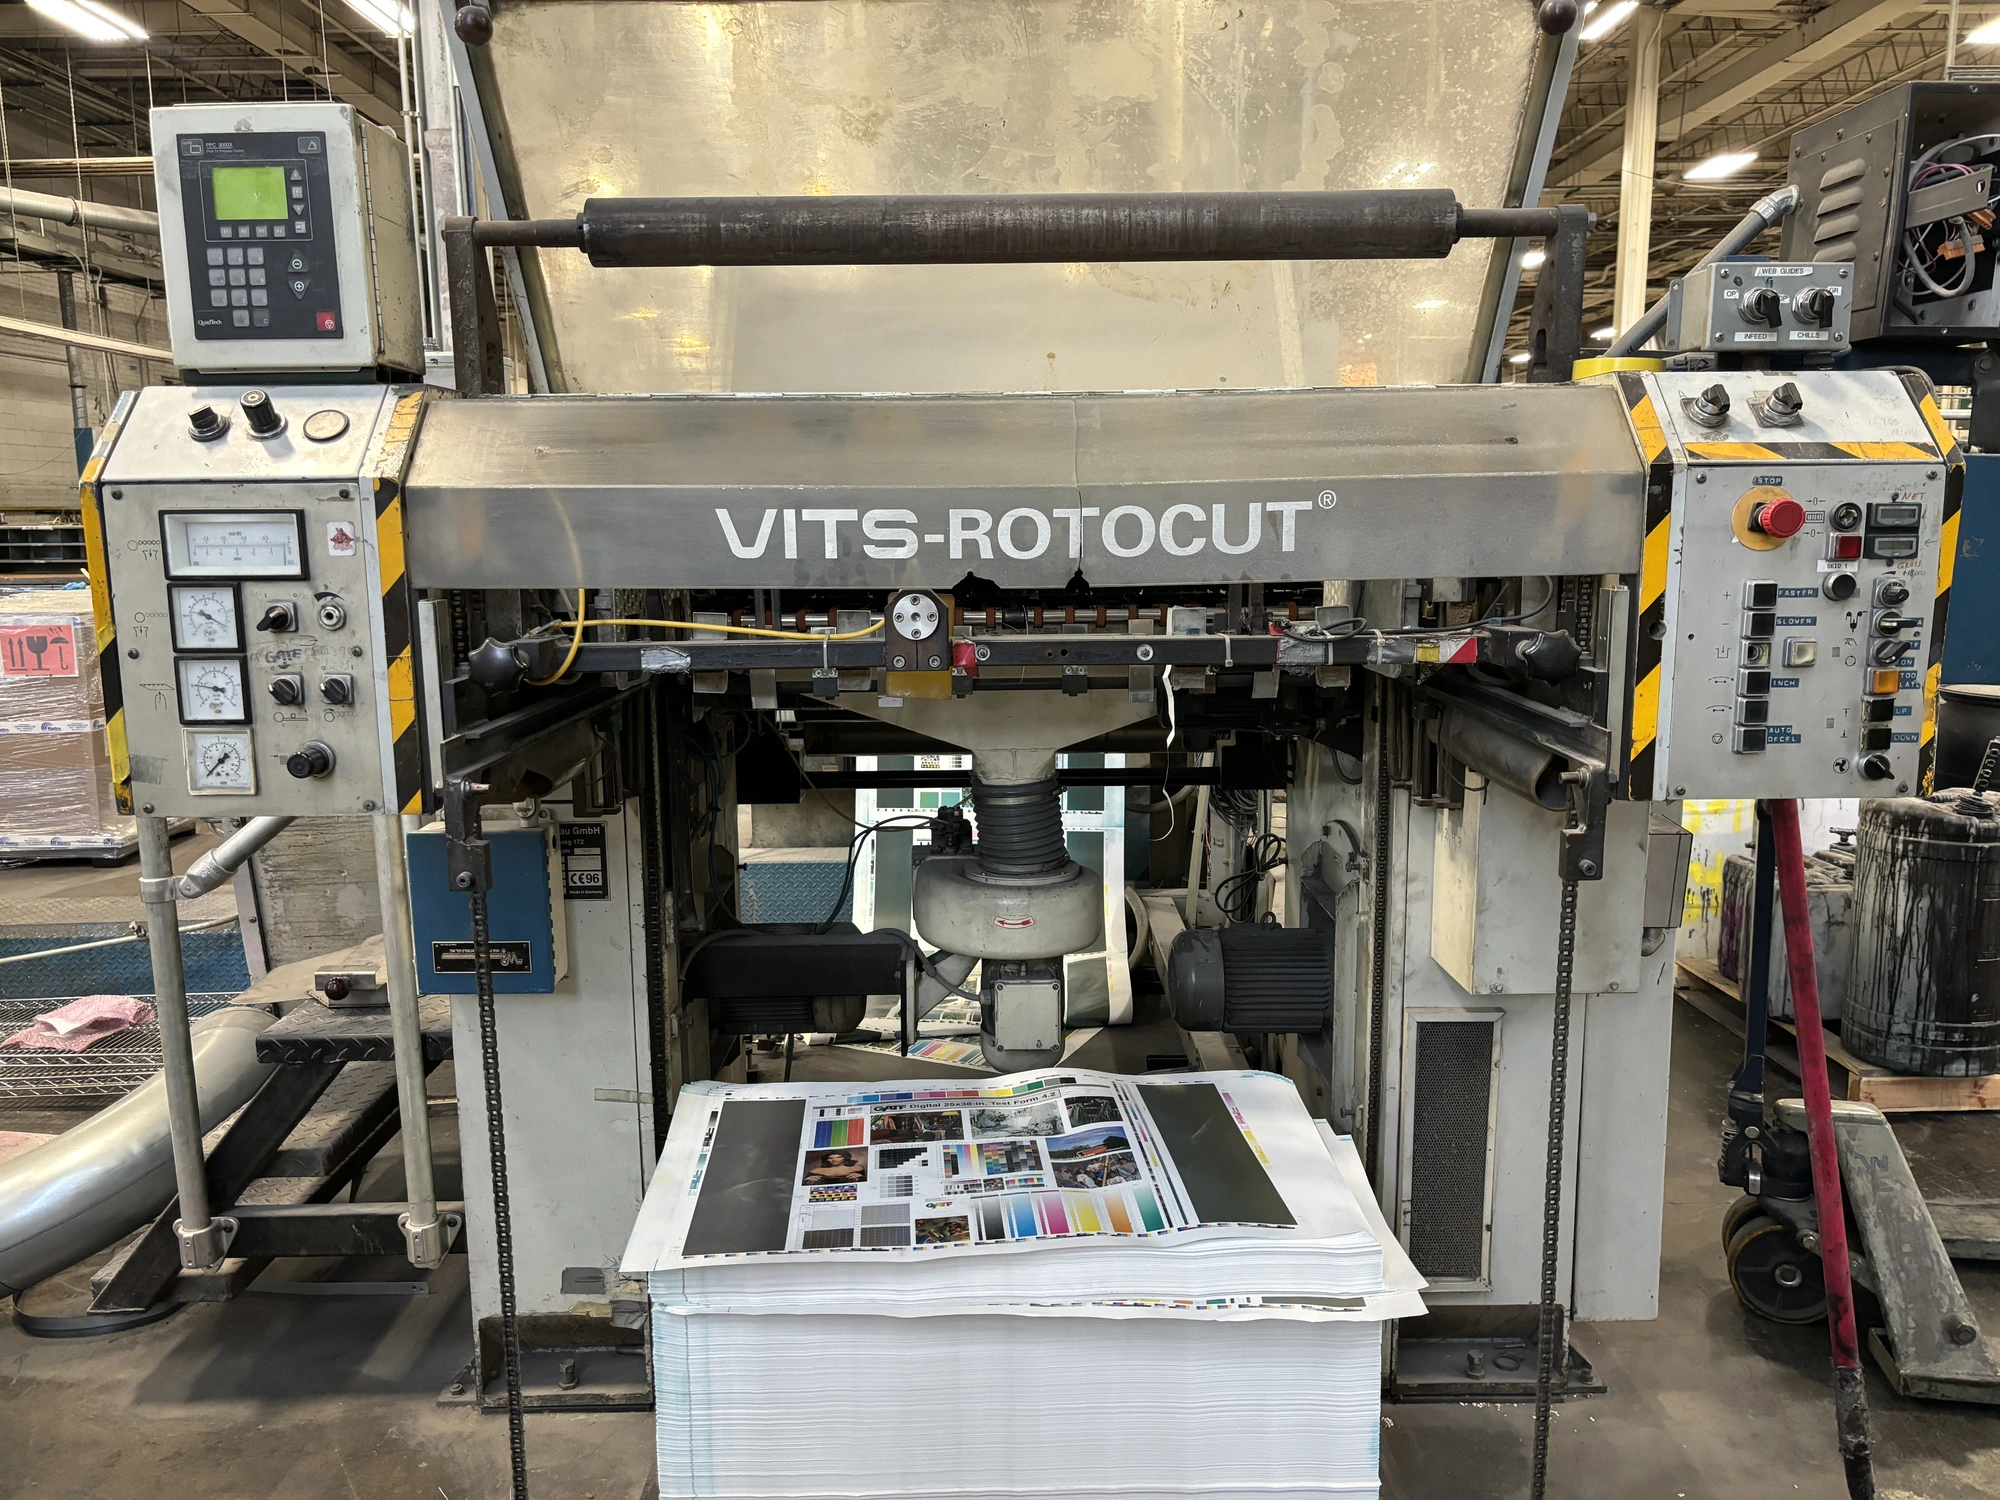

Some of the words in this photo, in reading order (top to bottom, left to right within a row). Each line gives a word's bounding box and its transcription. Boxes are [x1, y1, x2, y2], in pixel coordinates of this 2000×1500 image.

[1902, 492, 1927, 500] NET
[715, 500, 1312, 560] VITS-ROTOCUT
[873, 1104, 908, 1113] GATF
[1013, 1096, 1038, 1105] Form
